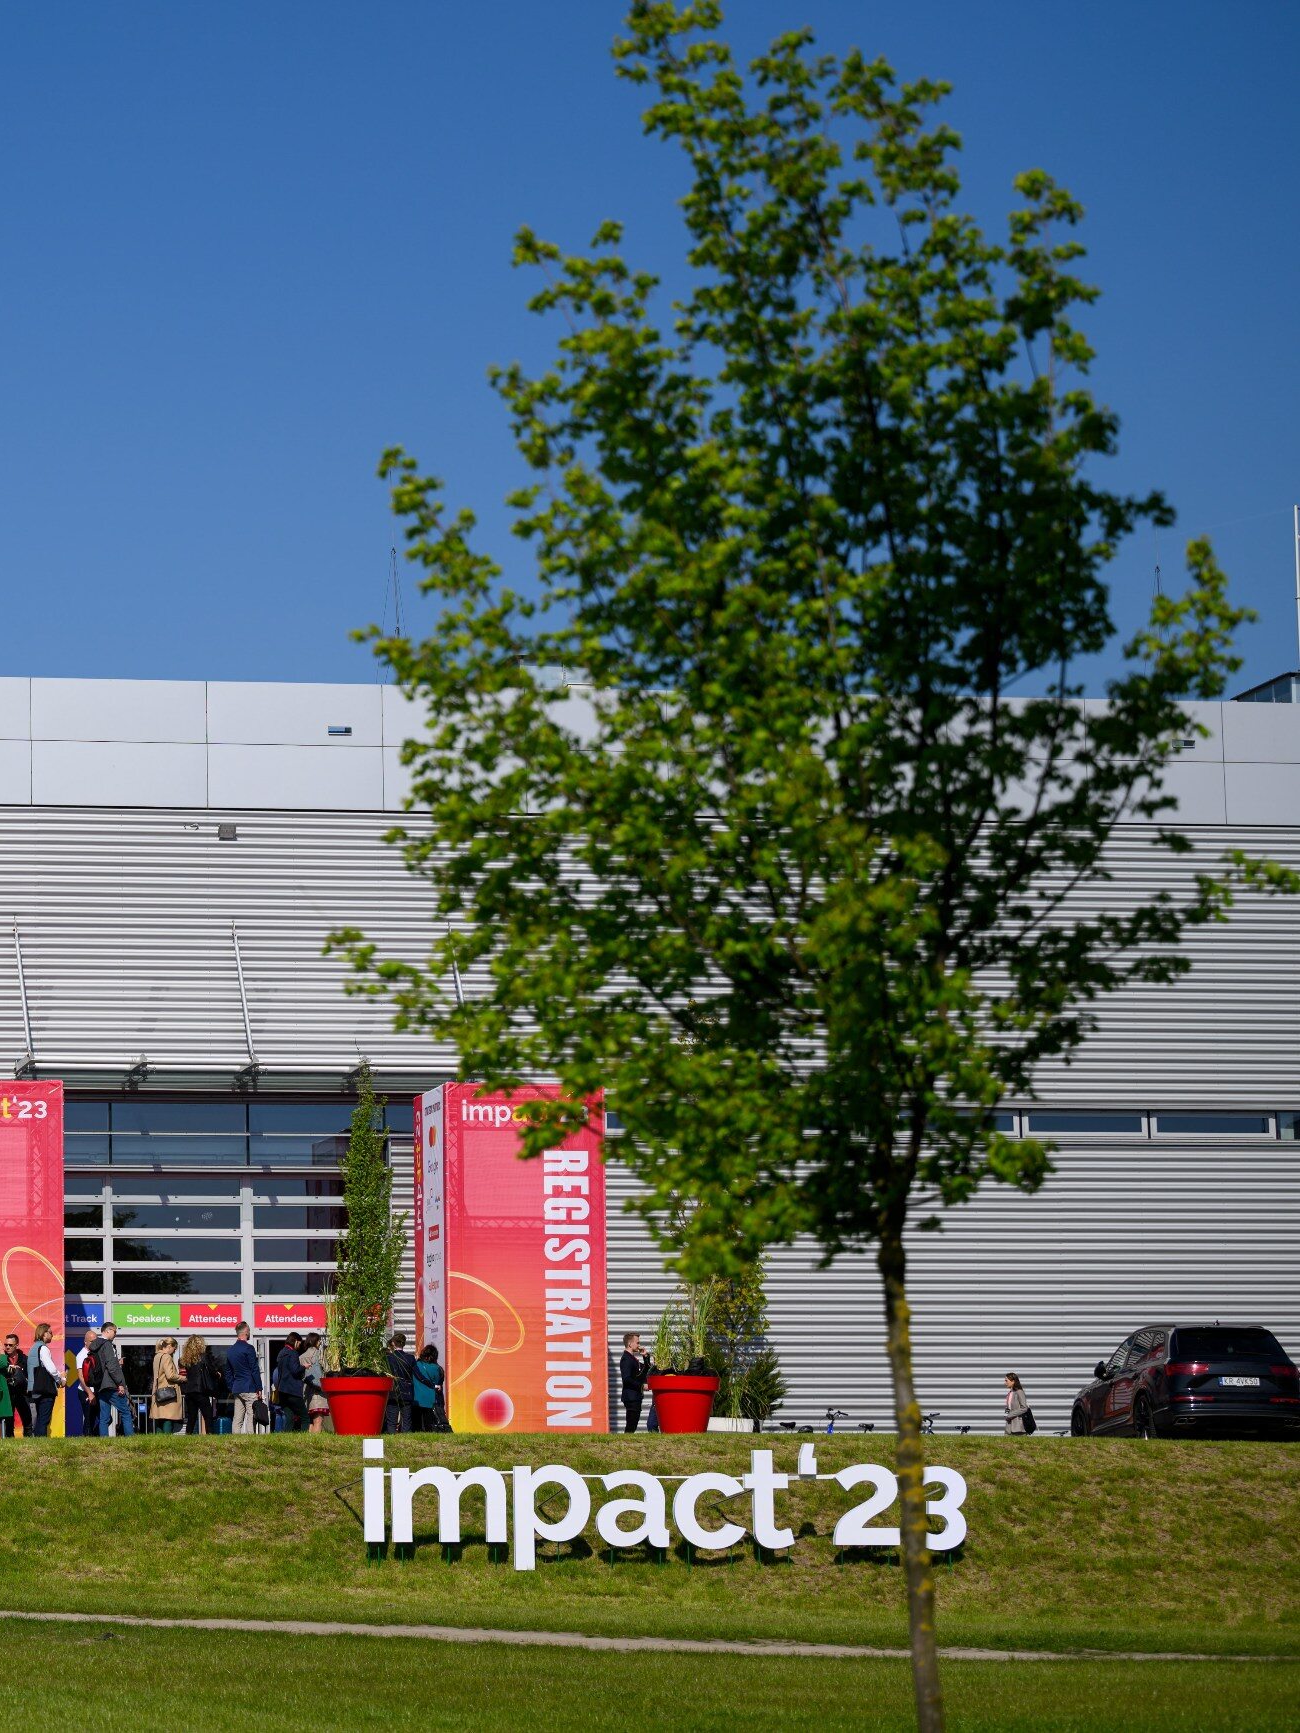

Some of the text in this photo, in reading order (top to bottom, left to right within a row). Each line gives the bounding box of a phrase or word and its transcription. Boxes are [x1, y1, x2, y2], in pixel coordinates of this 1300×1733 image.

[543, 1150, 592, 1427] REGISTRATION
[72, 1313, 98, 1323] Track
[126, 1314, 171, 1324] Speakers
[188, 1314, 238, 1323] Attendees
[265, 1314, 314, 1323] Attendees
[362, 1438, 968, 1571] impact'23
